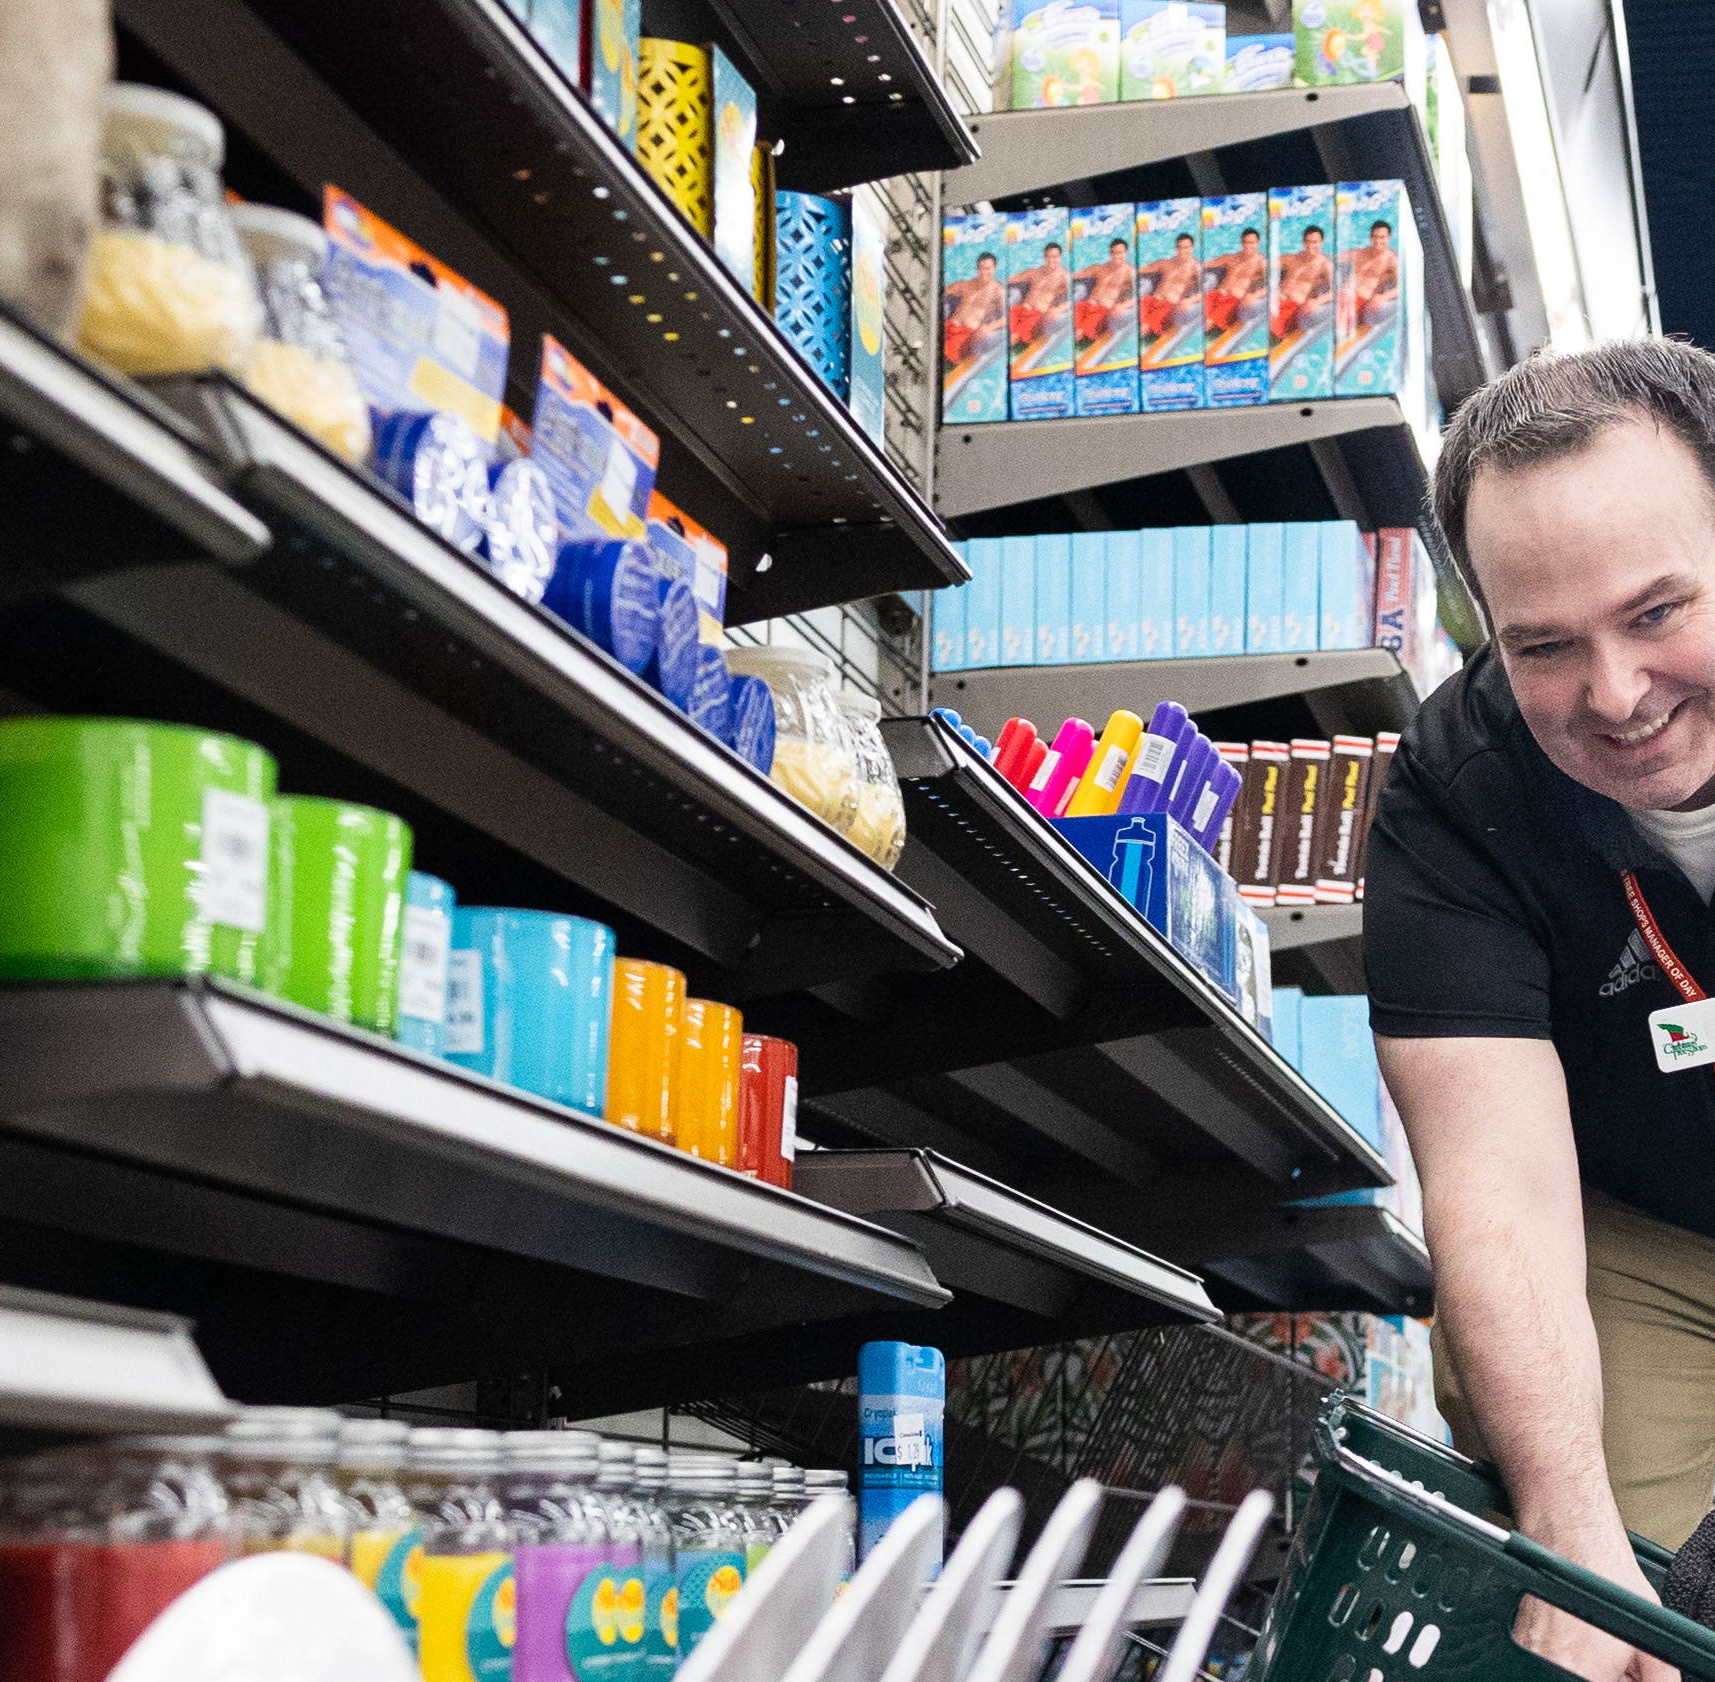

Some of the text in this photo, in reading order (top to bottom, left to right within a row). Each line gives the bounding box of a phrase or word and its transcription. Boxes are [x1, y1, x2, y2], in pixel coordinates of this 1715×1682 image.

[1630, 898, 1650, 928] SHOPS
[1644, 926, 1674, 970] MANAGER
[1670, 967, 1685, 980] OF
[1679, 979, 1697, 998] DAY
[864, 1437, 896, 1465] IC
